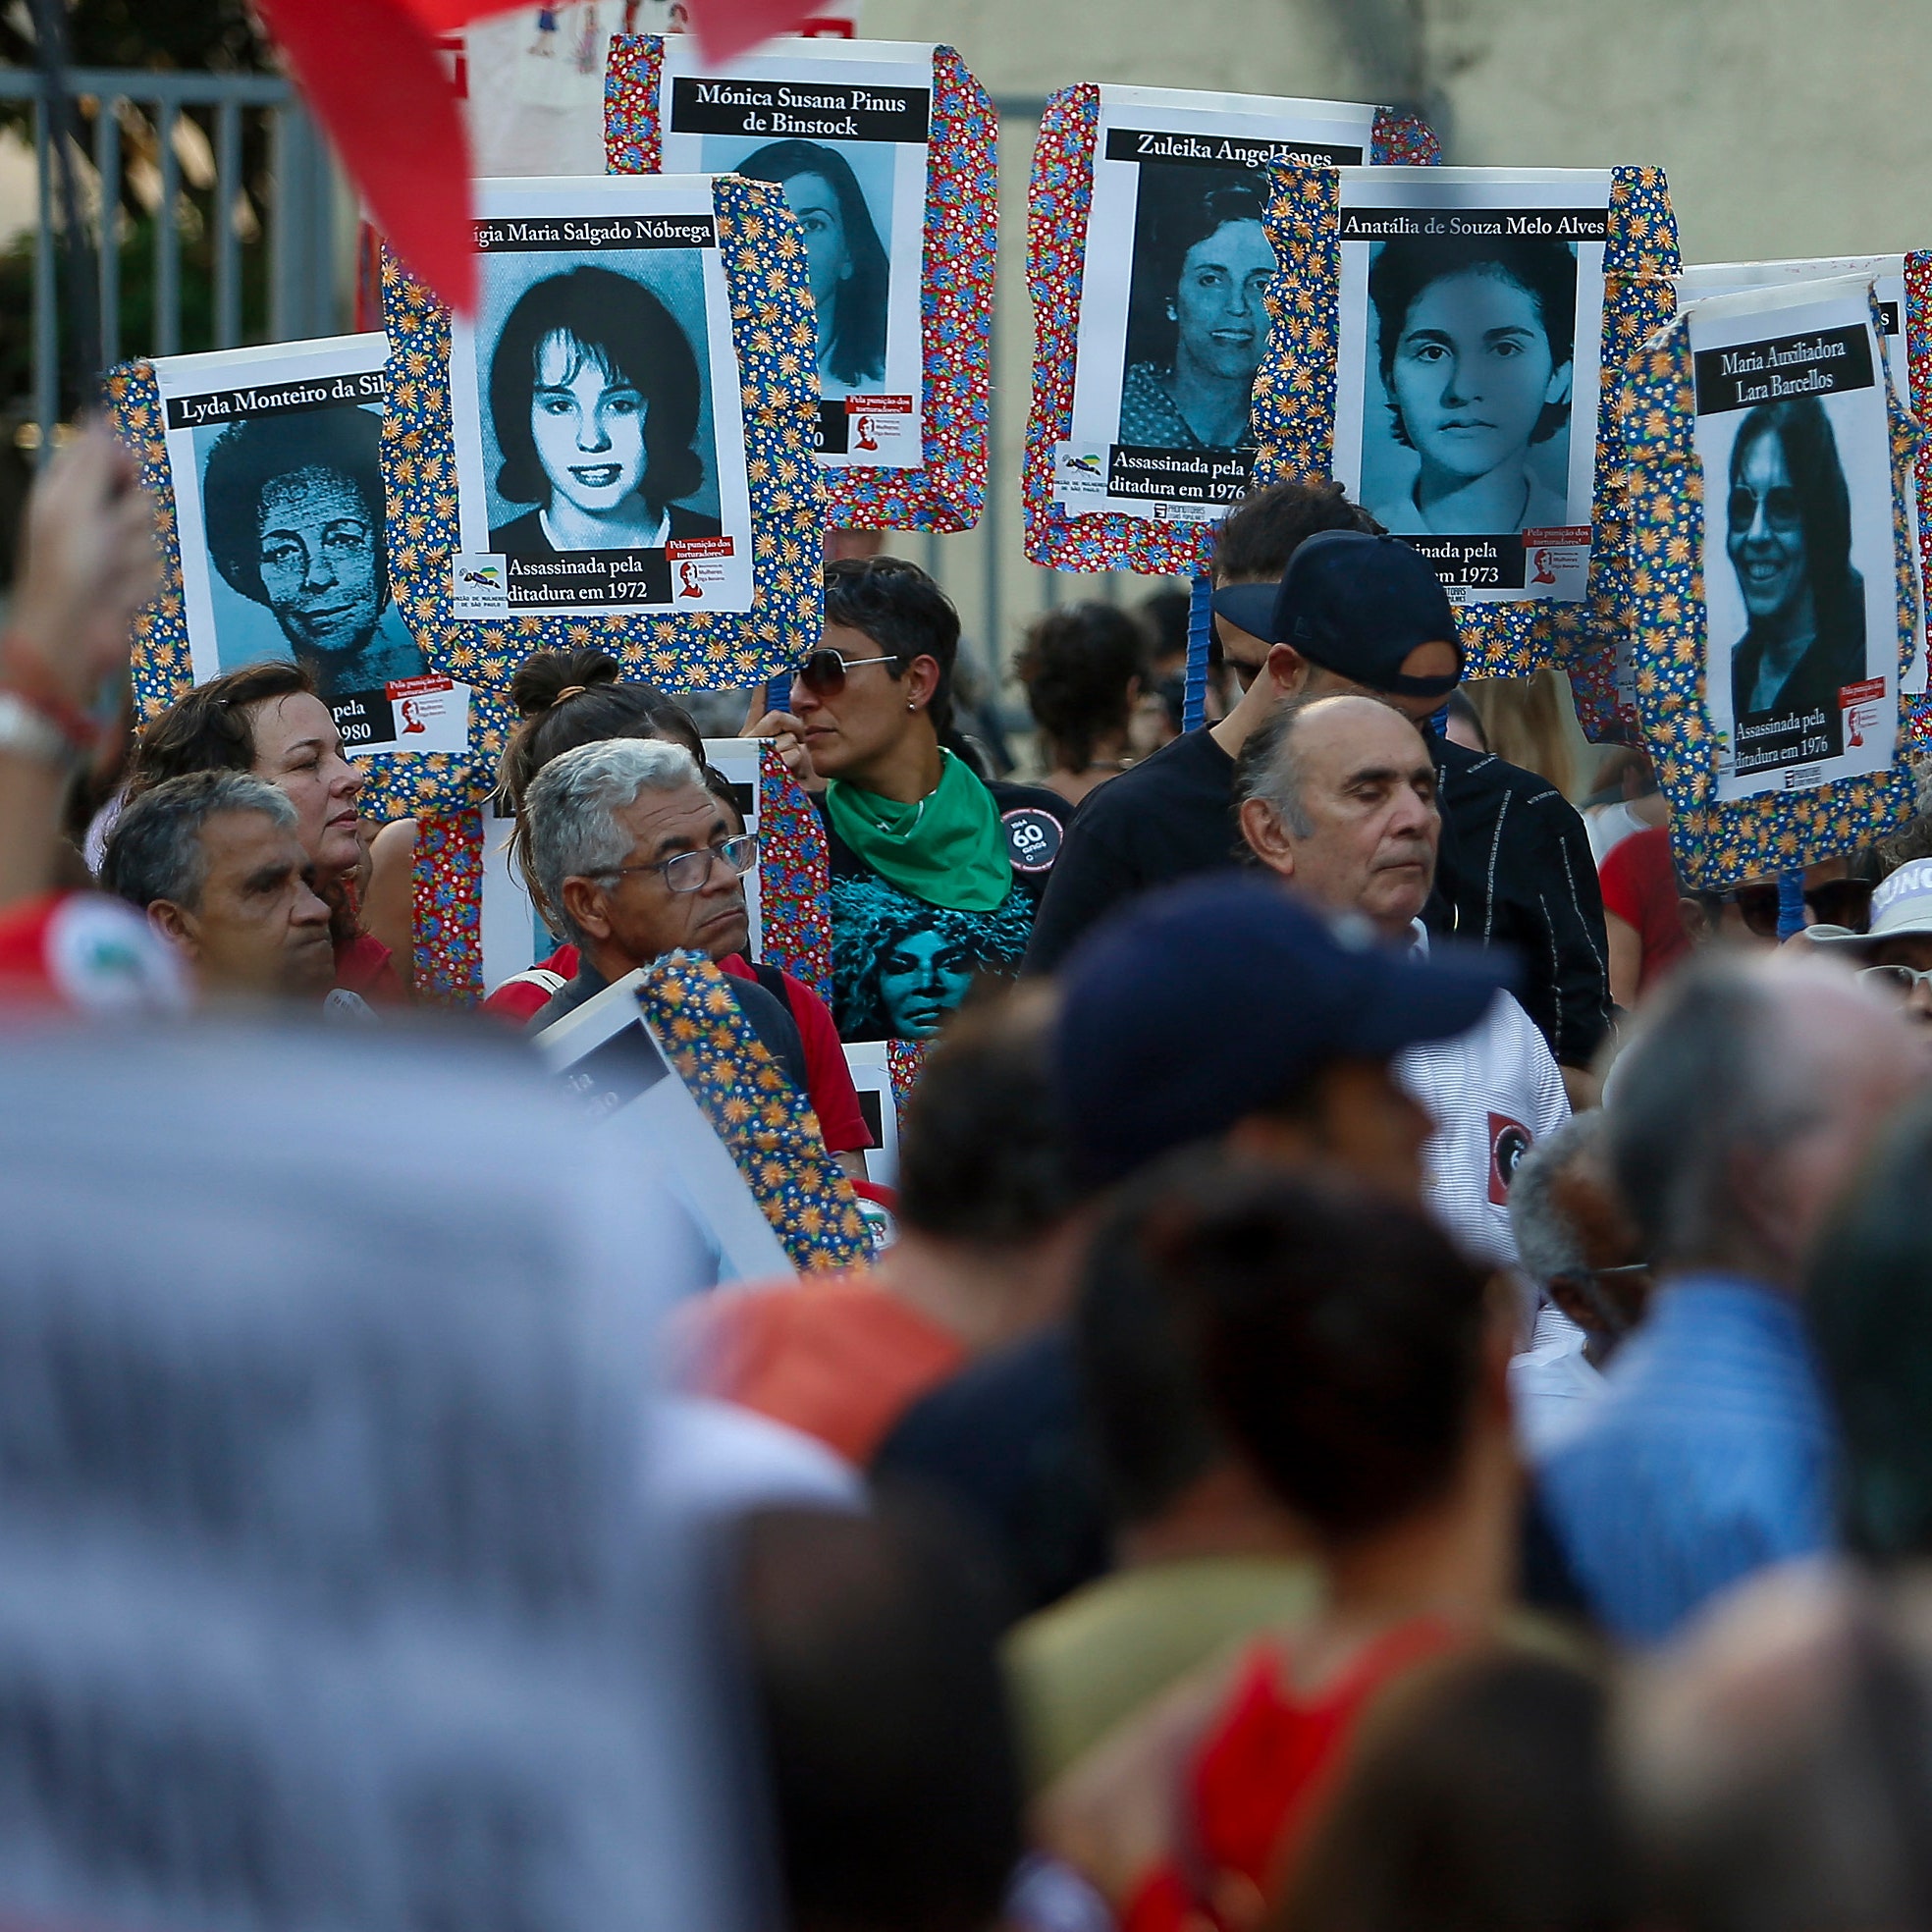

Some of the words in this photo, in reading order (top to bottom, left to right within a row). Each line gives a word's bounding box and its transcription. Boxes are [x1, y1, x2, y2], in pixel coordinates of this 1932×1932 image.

[695, 83, 774, 108] Mónica
[778, 86, 846, 111] Susana
[850, 90, 907, 113] Pinus
[742, 111, 768, 132] de
[771, 112, 859, 136] Binstock
[1137, 134, 1212, 159] Zuleika
[1215, 139, 1276, 168] Angel
[473, 226, 505, 247] ígia
[507, 223, 561, 242] Maria
[564, 221, 632, 246] Salgado
[635, 220, 711, 243] Nóbrega
[1343, 215, 1421, 235] Anatália
[1424, 217, 1445, 235] de
[1449, 217, 1502, 236] Souza
[1505, 216, 1552, 235] Melo
[1555, 216, 1605, 235] Alves
[1720, 350, 1764, 376] Maria
[1765, 338, 1846, 369] Auxiliadora
[1736, 380, 1769, 403] Lara
[1769, 368, 1834, 397] Barcellos
[180, 399, 231, 423] Lyda
[233, 386, 328, 412] Monteiro
[332, 379, 356, 400] da
[359, 374, 387, 397] Sil
[1113, 451, 1208, 475] Assassinada
[1211, 459, 1245, 479] pela
[1108, 475, 1175, 497] ditadura
[1178, 486, 1203, 499] em
[1207, 483, 1246, 501] 1976
[670, 540, 686, 549] Pela
[687, 540, 717, 552] punição
[717, 539, 731, 548] dos
[1416, 542, 1461, 559] inada
[1464, 542, 1498, 564] pela
[509, 556, 607, 576] Assassinada
[609, 555, 644, 578] pela
[1460, 566, 1499, 583] 1973
[508, 583, 575, 602] ditadura
[578, 587, 604, 600] em
[608, 581, 648, 599] 1972
[333, 699, 366, 723] pela
[340, 723, 371, 740] 980
[1736, 711, 1800, 741] Assassinada
[1802, 708, 1826, 733] pela
[1735, 747, 1779, 770] ditadura
[1780, 748, 1798, 760] em
[1800, 735, 1829, 756] 1976
[1012, 824, 1044, 847] 60
[1022, 840, 1047, 854] anos
